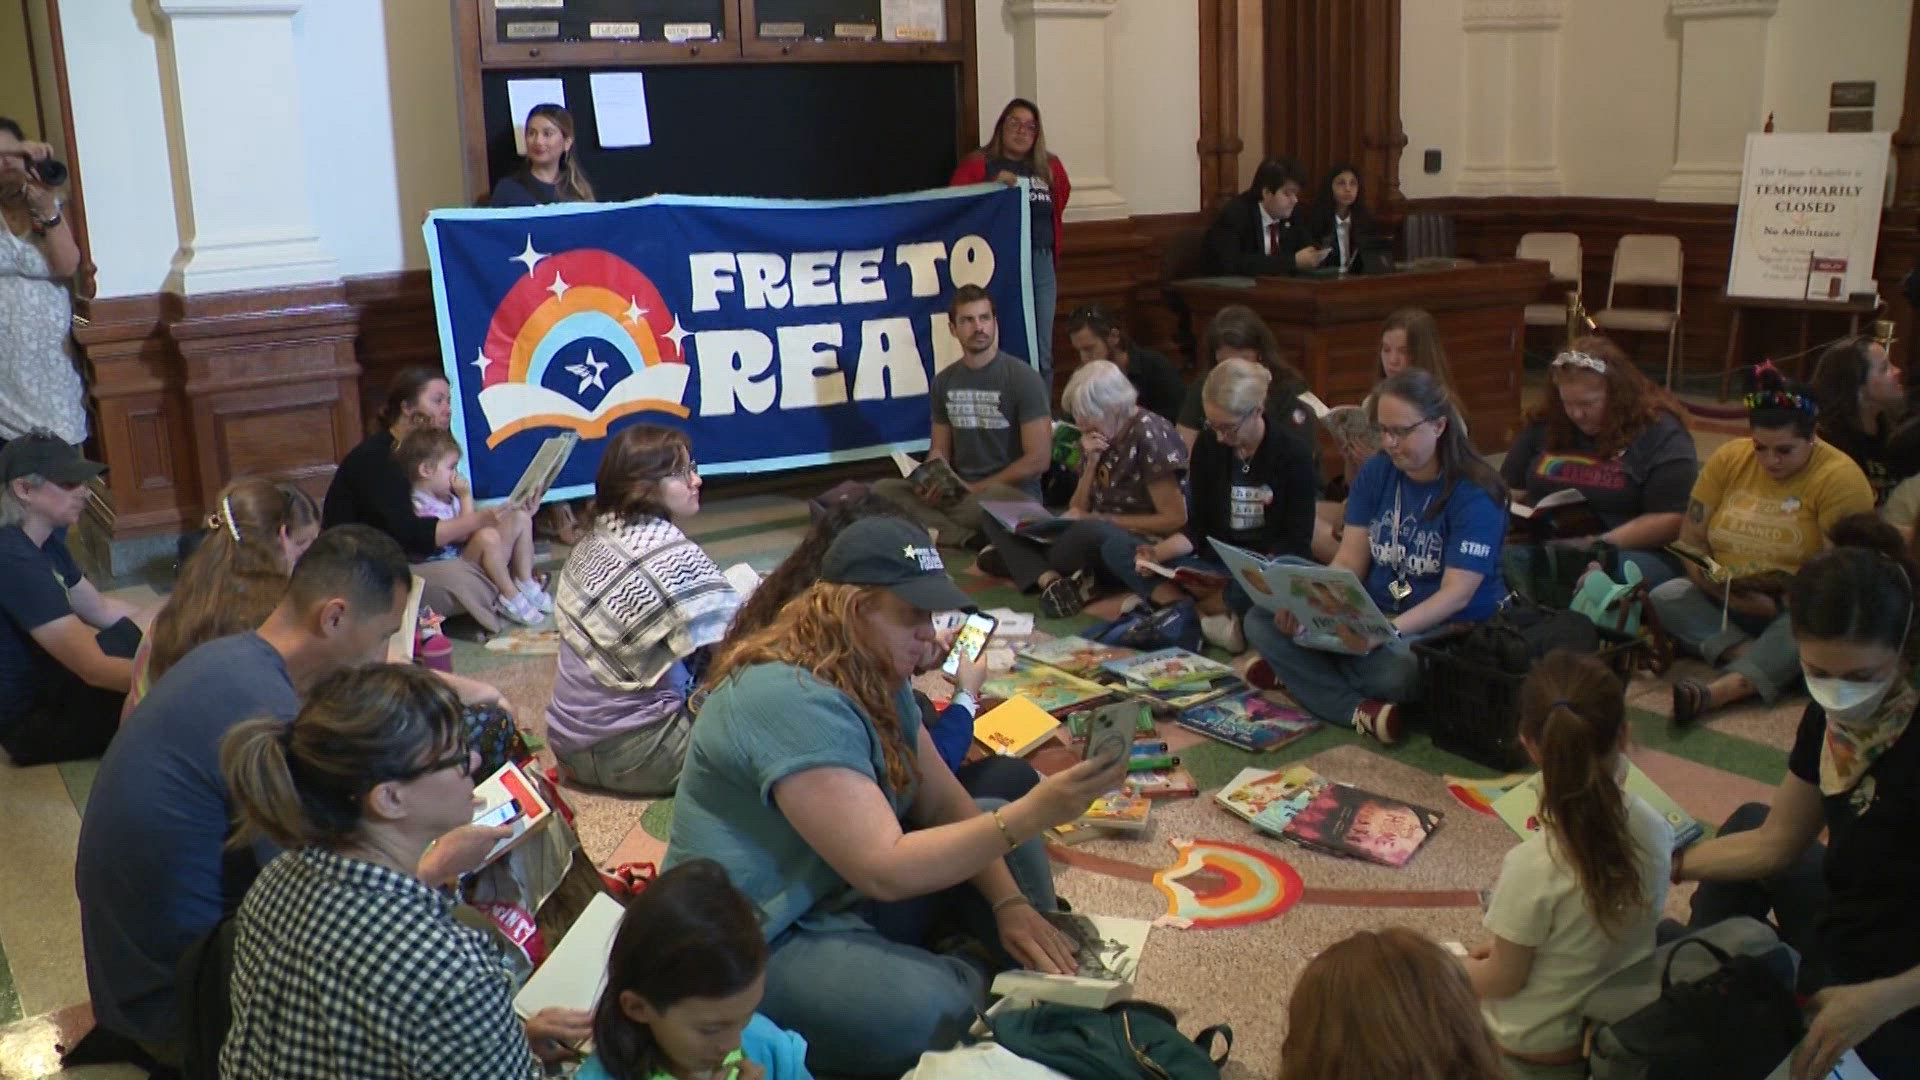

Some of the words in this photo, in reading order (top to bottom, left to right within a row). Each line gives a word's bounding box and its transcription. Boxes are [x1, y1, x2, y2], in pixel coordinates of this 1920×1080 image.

[1755, 184, 1864, 197] TEMPORARILY
[1775, 202, 1836, 213] CLOSED
[1763, 226, 1778, 236] No
[1782, 226, 1841, 237] Admittance
[690, 247, 888, 313] FREE
[896, 234, 996, 297] TO
[1460, 540, 1491, 558] STAFF
